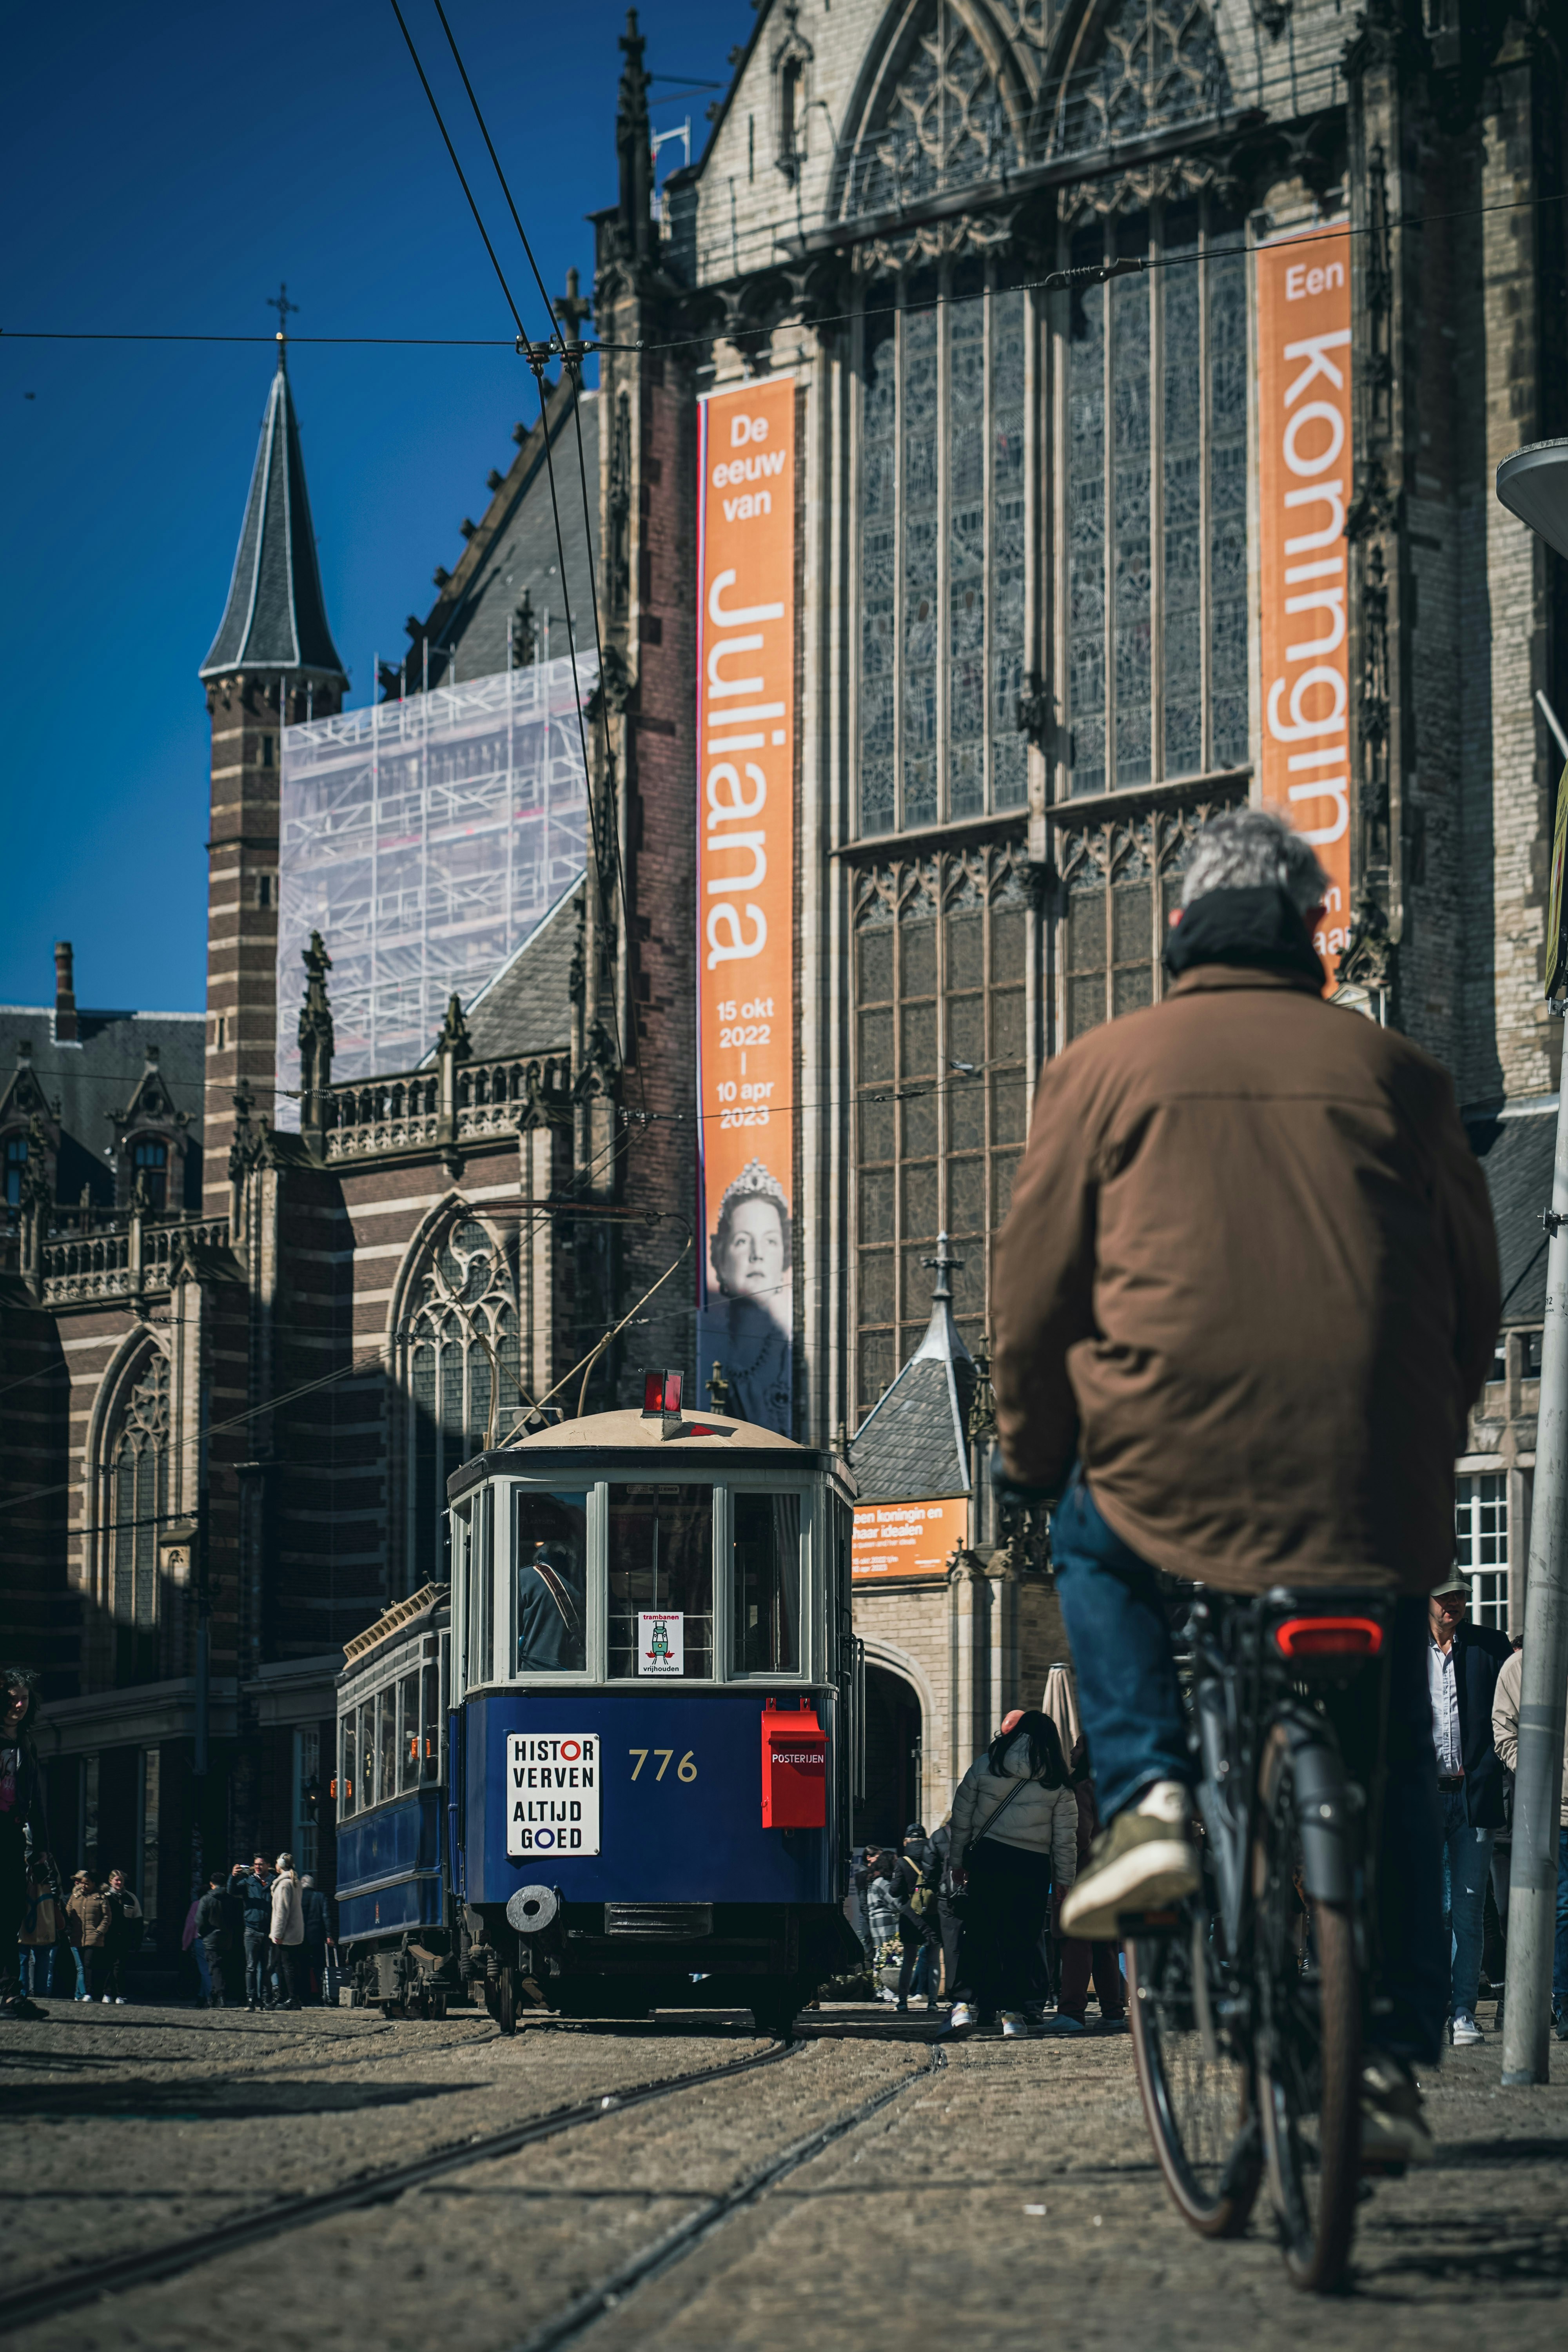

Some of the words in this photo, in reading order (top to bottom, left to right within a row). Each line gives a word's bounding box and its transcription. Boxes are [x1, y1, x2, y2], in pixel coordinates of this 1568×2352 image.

[1286, 261, 1344, 301] Een
[731, 414, 768, 447] De
[712, 449, 786, 488] eeuw
[723, 490, 771, 523] van
[706, 568, 786, 970] Juliana
[717, 1000, 737, 1021] 15
[741, 997, 774, 1018] okt
[719, 1024, 771, 1048] 2022
[716, 1081, 737, 1102] 10
[740, 1082, 774, 1103] apr
[720, 1105, 770, 1129] 2023
[877, 1506, 926, 1524] koningin
[927, 1507, 943, 1519] en
[853, 1526, 879, 1540] haar
[881, 1523, 923, 1538] idealen
[515, 1740, 593, 1761] HISTOR
[772, 1754, 824, 1763] POSTERIJEN
[513, 1767, 593, 1788] VERVEN
[629, 1749, 697, 1782] 776
[513, 1801, 582, 1822] ALTIJD
[521, 1828, 582, 1849] GOED
